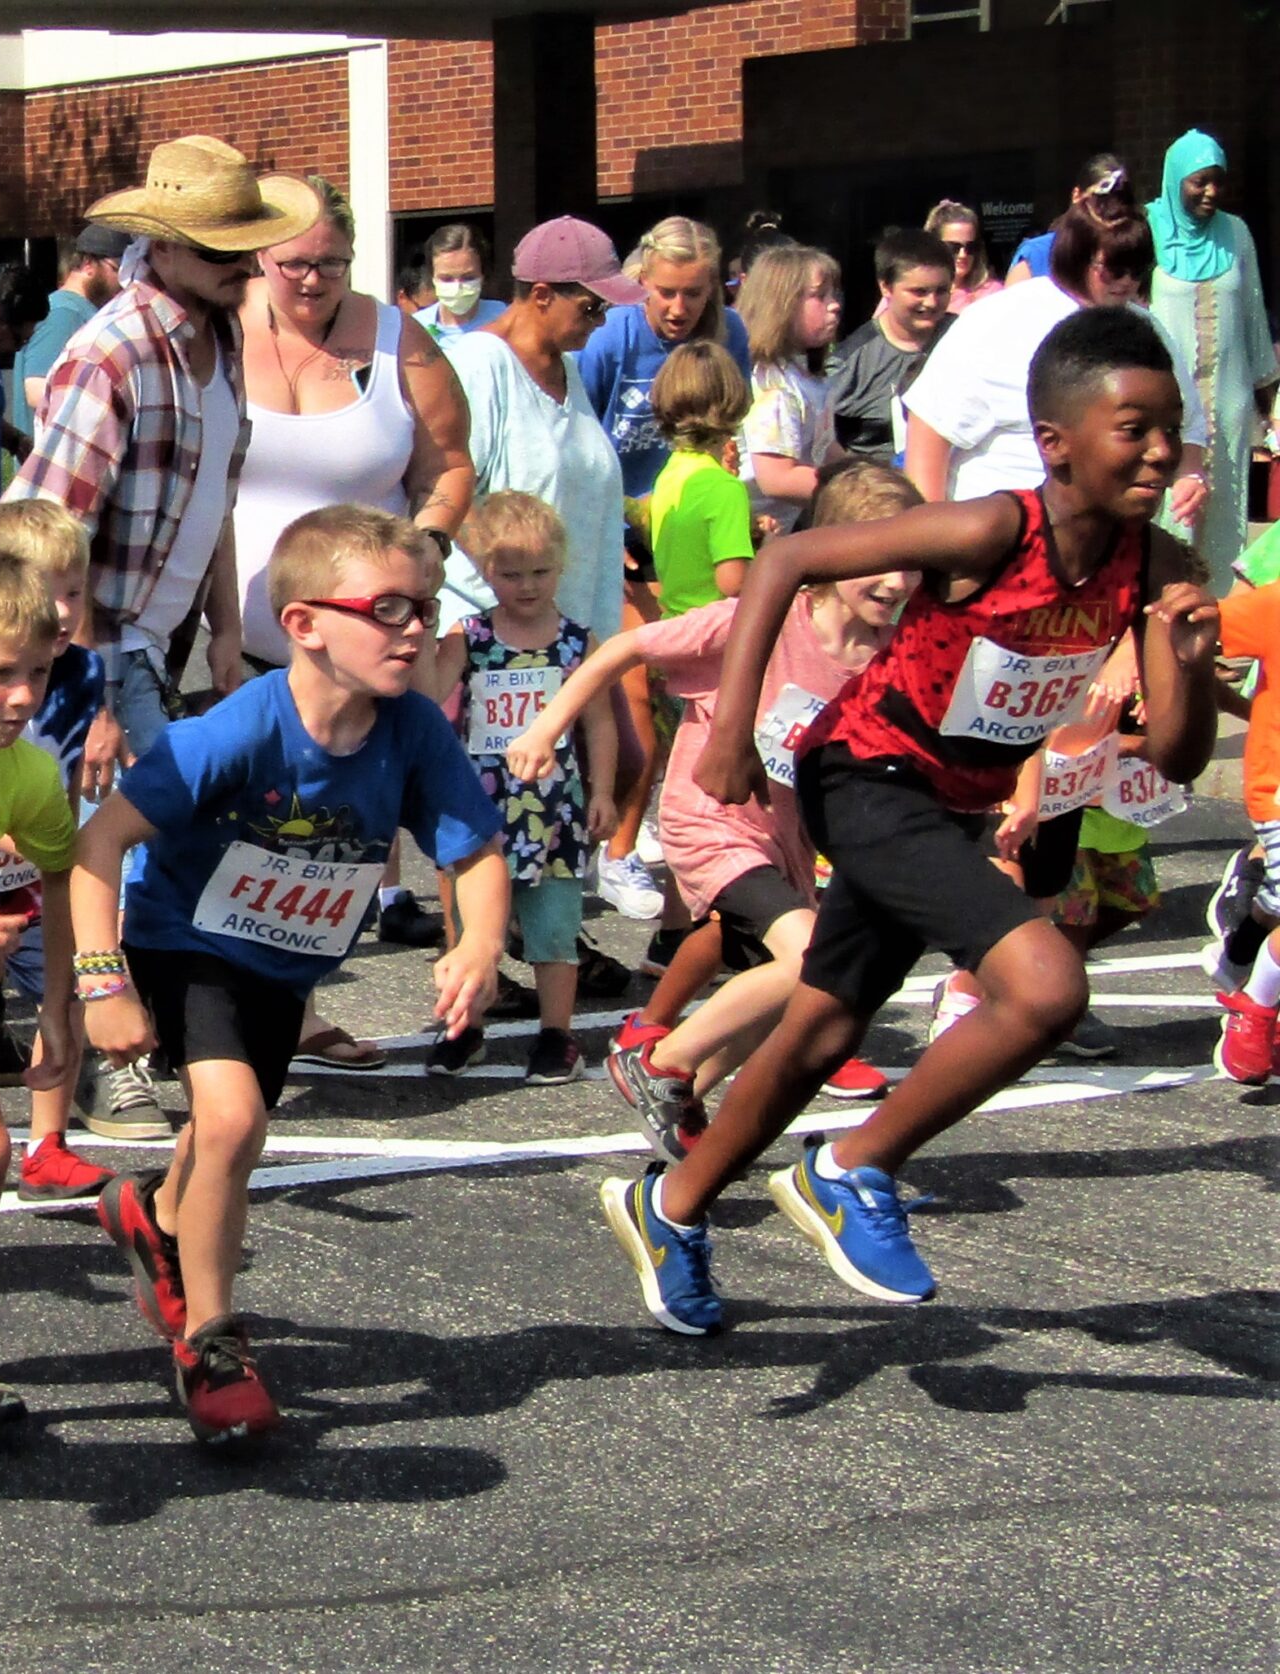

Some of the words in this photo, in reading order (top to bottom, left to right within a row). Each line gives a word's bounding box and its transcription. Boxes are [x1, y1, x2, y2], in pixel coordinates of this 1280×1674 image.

[982, 201, 1033, 216] Welcome
[1024, 607, 1101, 639] RUN
[1001, 656, 1034, 675] JR.
[1043, 660, 1077, 674] BIX
[509, 672, 534, 686] BIX
[537, 671, 545, 684] 7
[969, 717, 1049, 740] ARCON
[261, 855, 291, 875] JR.
[301, 863, 340, 881] BIX
[346, 867, 359, 882] 7
[229, 874, 355, 928] F1444
[222, 913, 328, 950] ARCONIC
